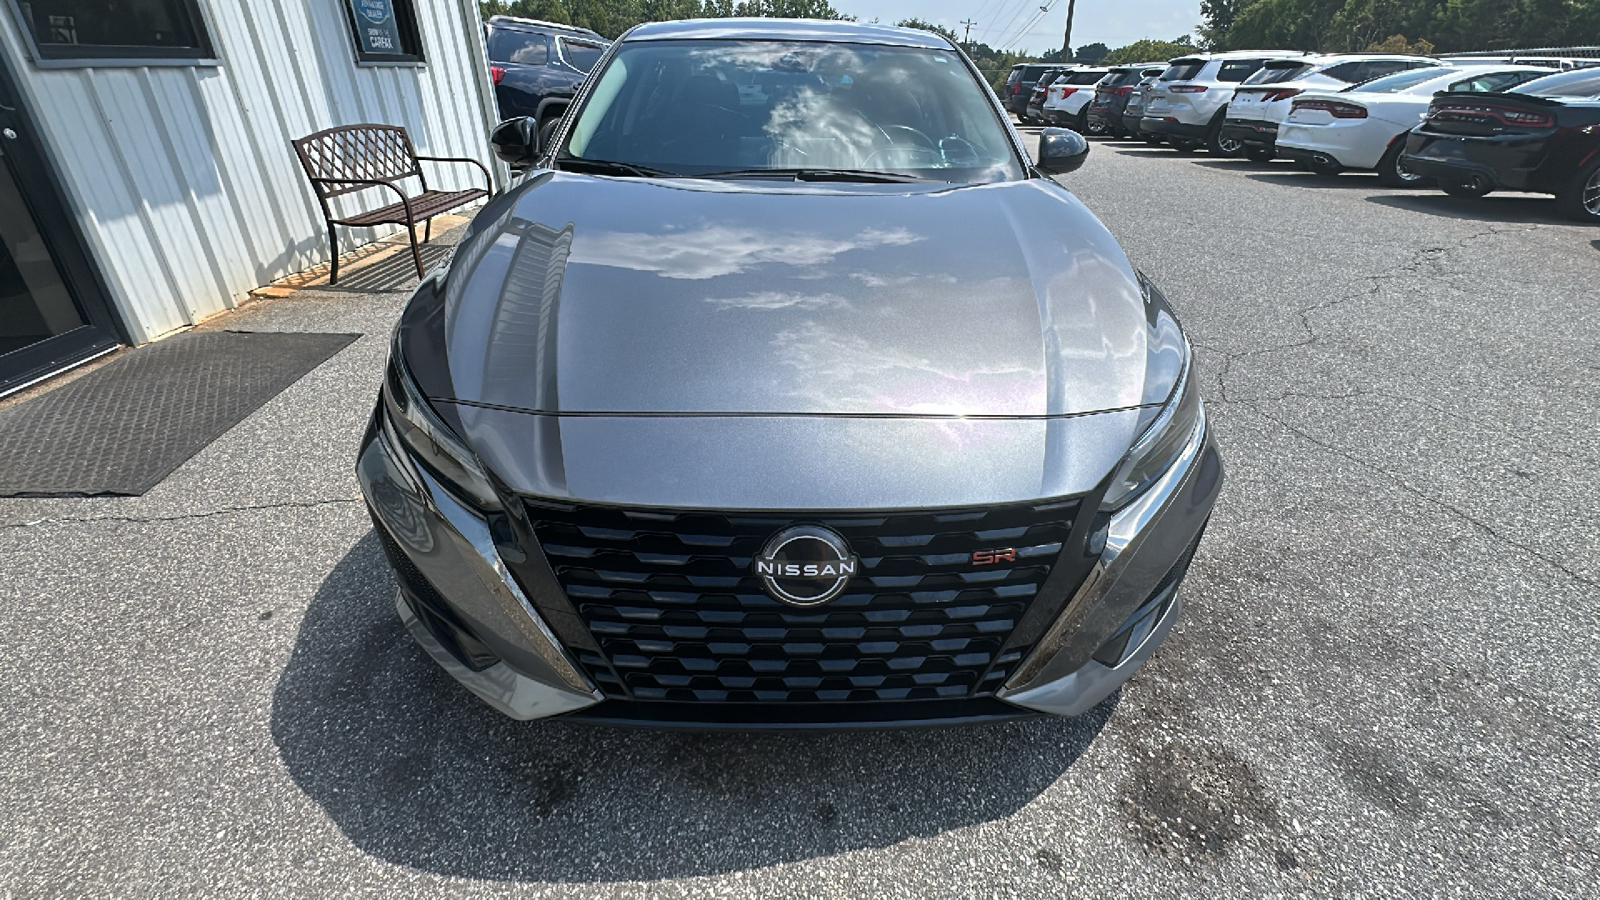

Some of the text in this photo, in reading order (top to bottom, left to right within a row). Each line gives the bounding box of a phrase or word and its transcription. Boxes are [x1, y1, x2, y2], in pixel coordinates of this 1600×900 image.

[369, 36, 393, 49] CARFAX
[972, 547, 1016, 566] SR
[757, 561, 855, 576] NISSAN
